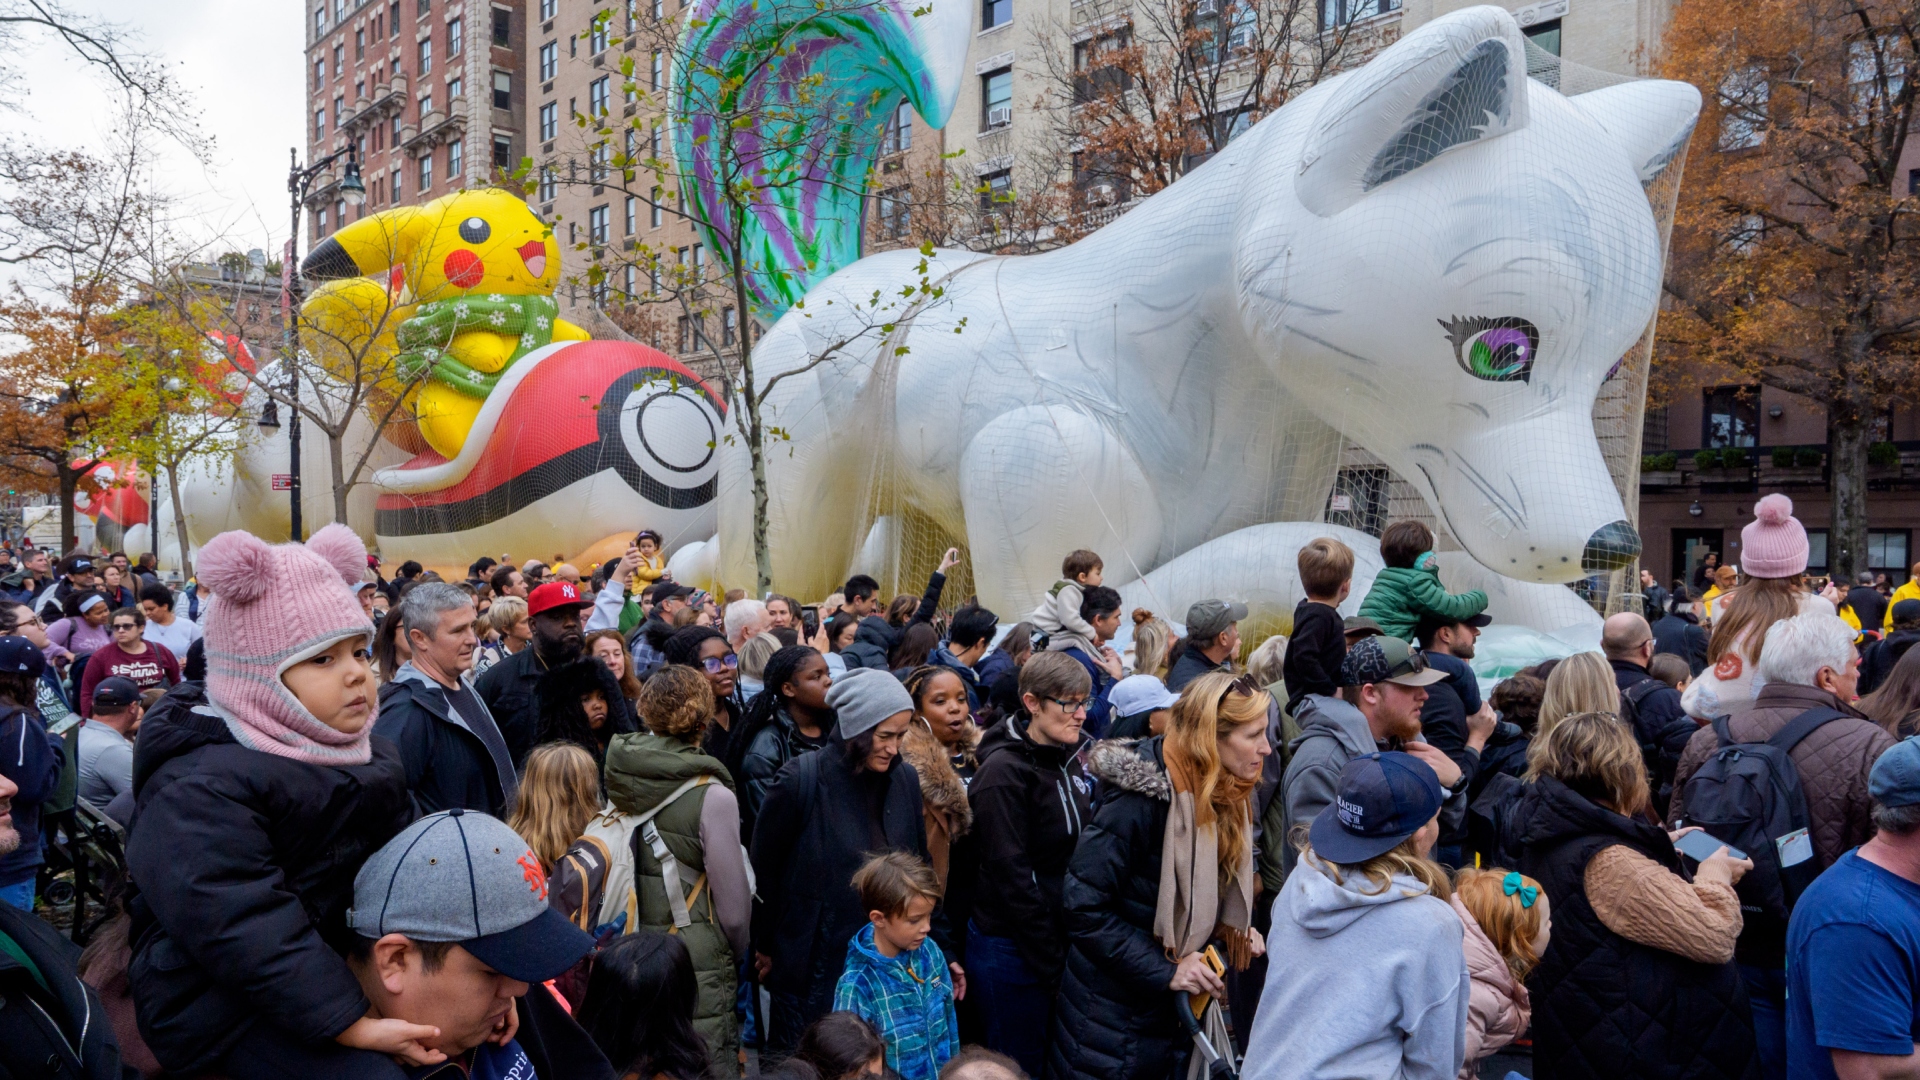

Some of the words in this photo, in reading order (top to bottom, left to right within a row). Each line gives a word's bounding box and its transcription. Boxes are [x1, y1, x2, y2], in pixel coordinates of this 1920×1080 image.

[561, 584, 576, 598] NY
[516, 849, 549, 902] NY
[1740, 904, 1763, 913] AMES
[503, 1051, 528, 1080] spri
